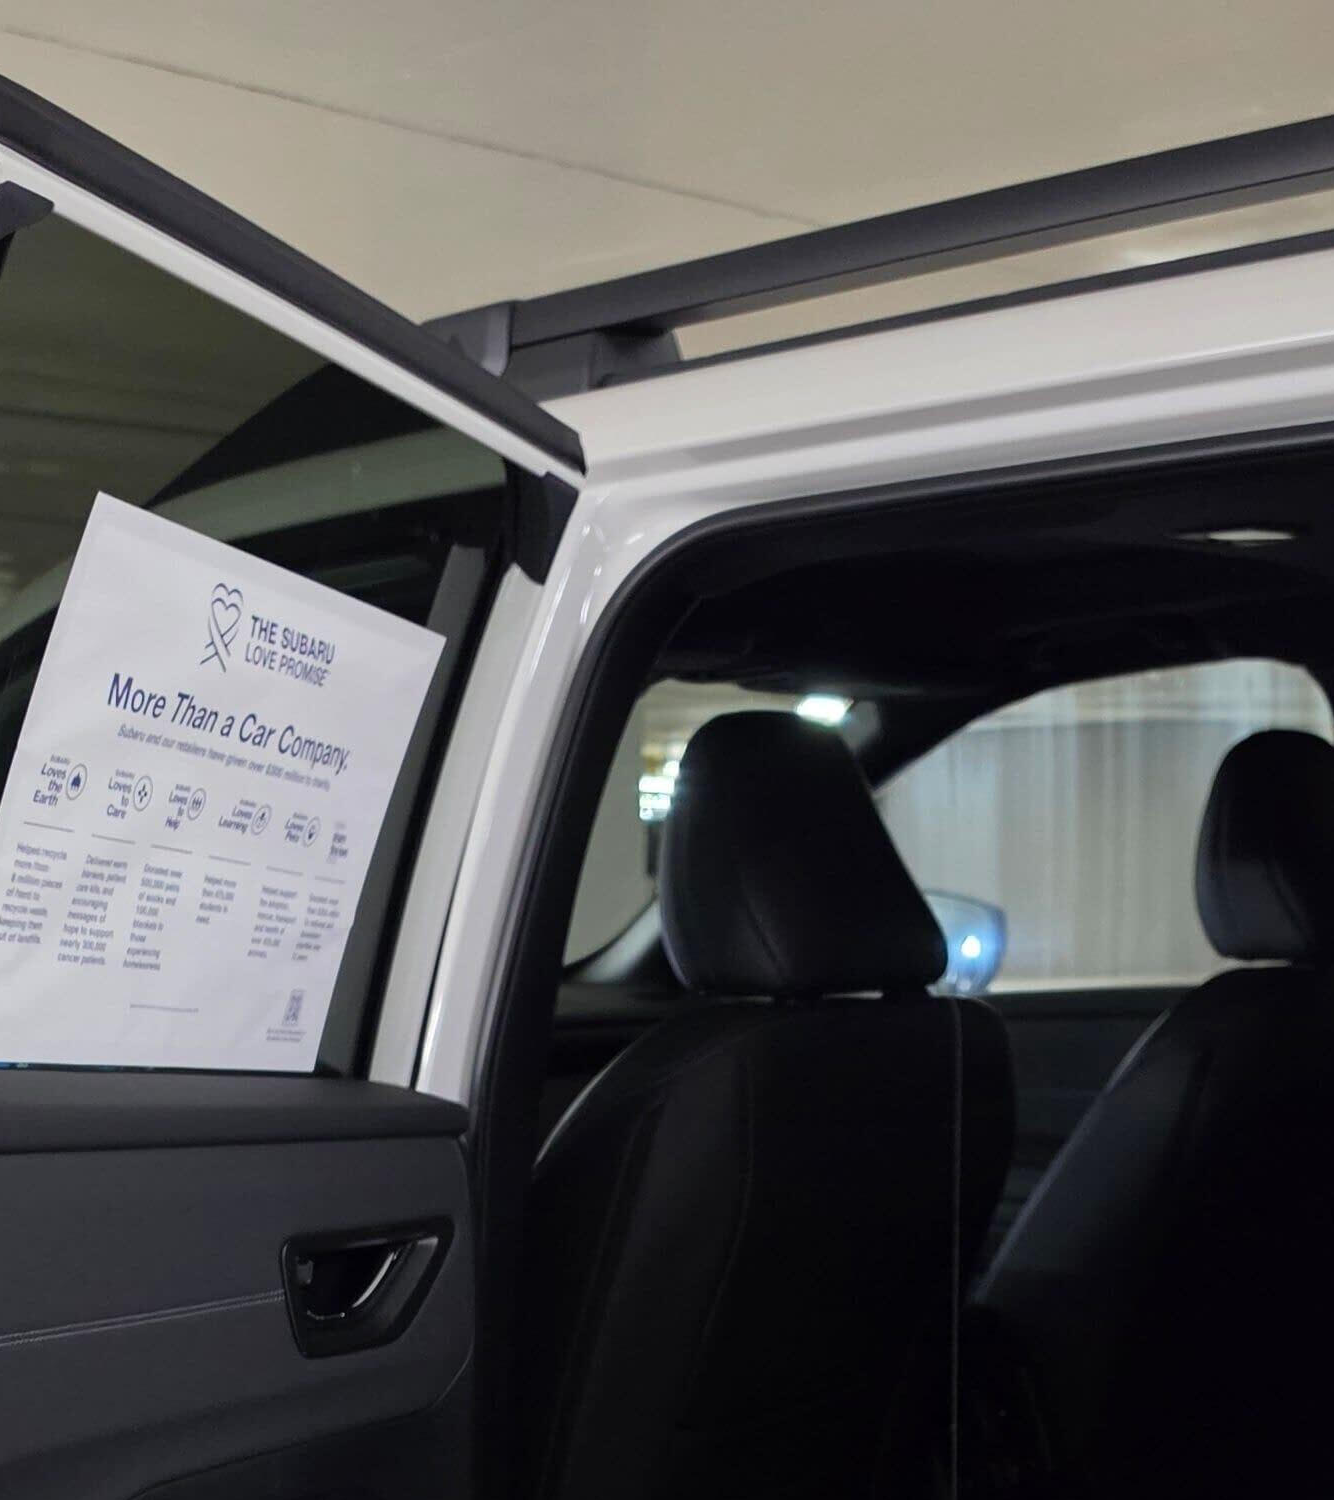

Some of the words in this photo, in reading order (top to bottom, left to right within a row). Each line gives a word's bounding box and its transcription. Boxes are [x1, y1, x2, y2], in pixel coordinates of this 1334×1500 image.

[251, 615, 278, 645] THE
[281, 627, 336, 665] SUBARU
[245, 641, 276, 671] LOVE
[278, 655, 331, 687] PROMISE
[107, 673, 167, 718] More
[171, 692, 220, 734] Than
[220, 715, 235, 737] a
[239, 713, 276, 749] Car
[278, 725, 351, 776] Company.
[117, 723, 146, 742] Subaru
[146, 732, 162, 746] and
[161, 736, 175, 748] our
[207, 746, 225, 762] have
[225, 753, 248, 768] given
[248, 760, 265, 773] over
[41, 763, 67, 780] Loves
[47, 779, 63, 793] the
[108, 777, 132, 794] Loves
[33, 789, 59, 807] Earth
[121, 795, 129, 807] to
[169, 791, 188, 806] Loves
[106, 803, 127, 820] Care
[232, 806, 253, 820] Loves
[218, 816, 248, 835] Learning
